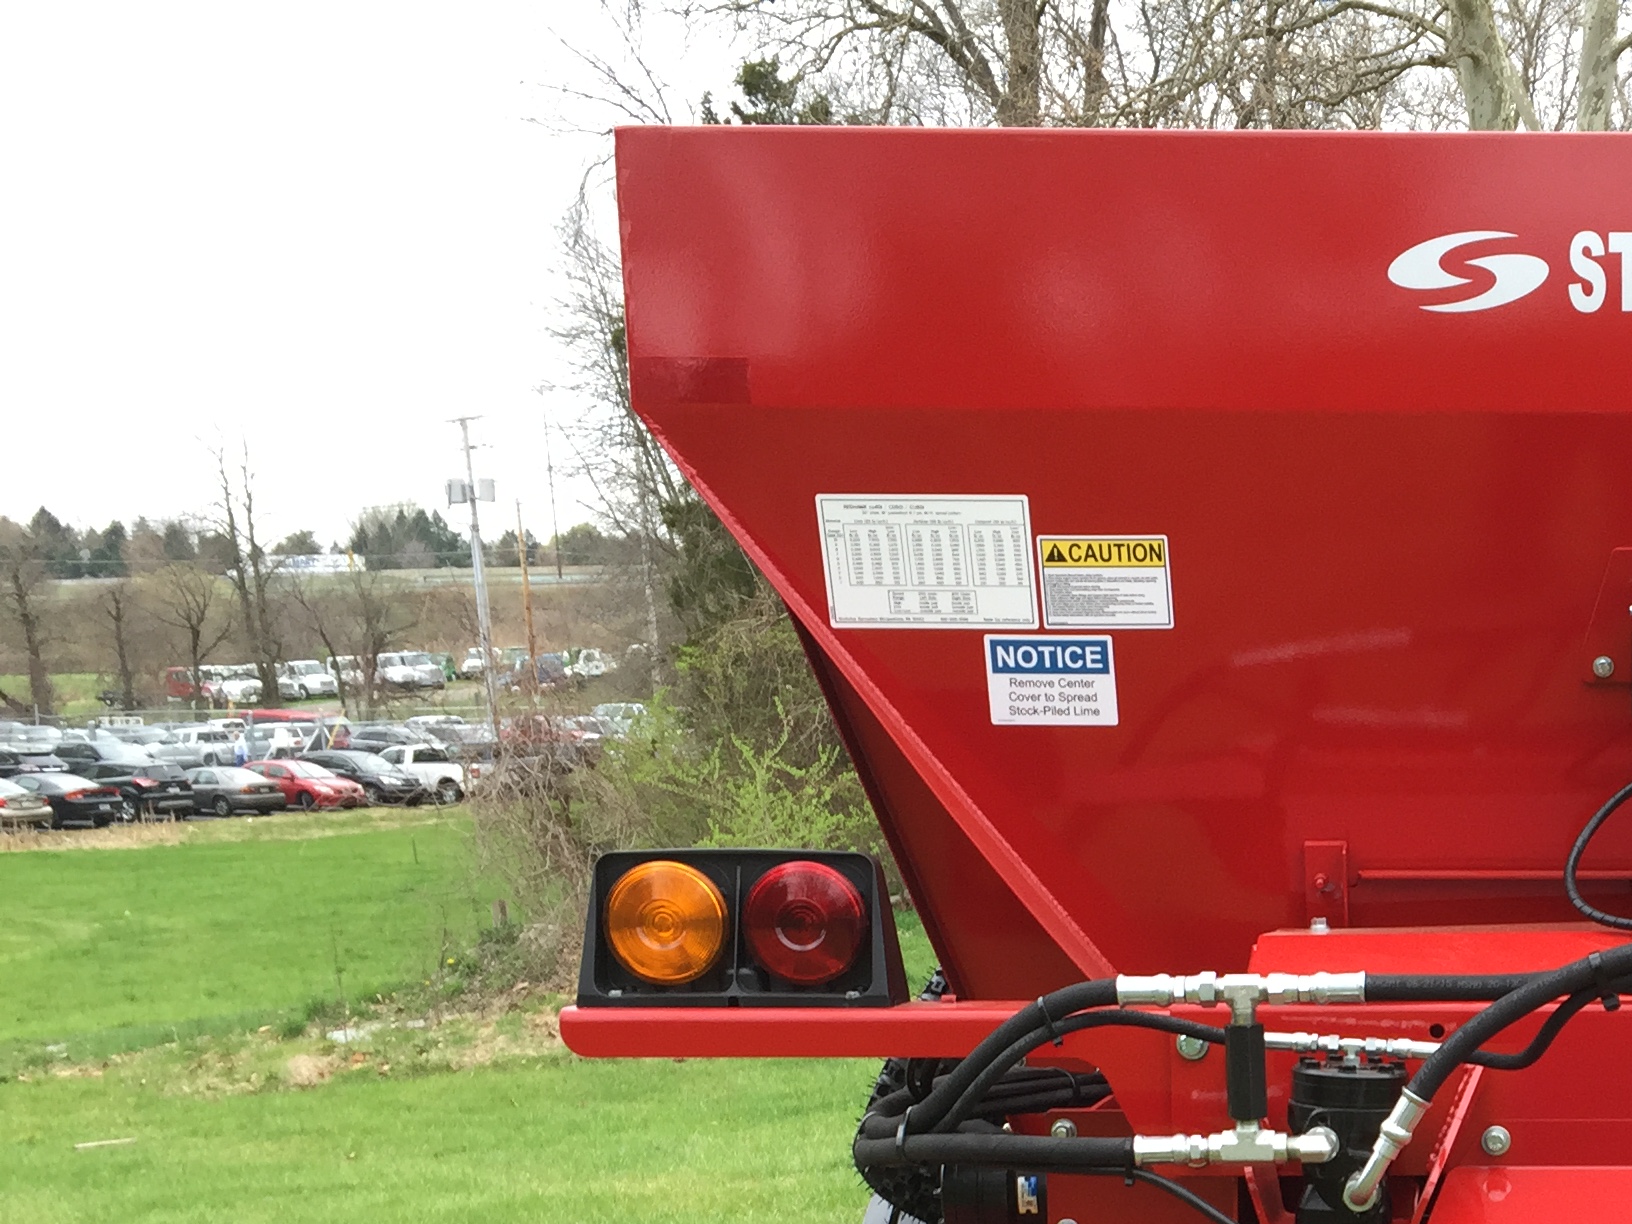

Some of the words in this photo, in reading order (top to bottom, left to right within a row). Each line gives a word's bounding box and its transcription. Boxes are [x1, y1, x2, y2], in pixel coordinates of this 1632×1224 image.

[1068, 542, 1163, 563] CAUTION
[996, 645, 1104, 669] NOTICE
[1009, 677, 1055, 688] Remove
[1057, 677, 1096, 688] Center
[1008, 691, 1041, 702] Cover
[1044, 692, 1055, 702] to
[1058, 691, 1098, 704] Spread
[1008, 705, 1070, 716] Stock-Piled
[1073, 706, 1101, 716] Lime
